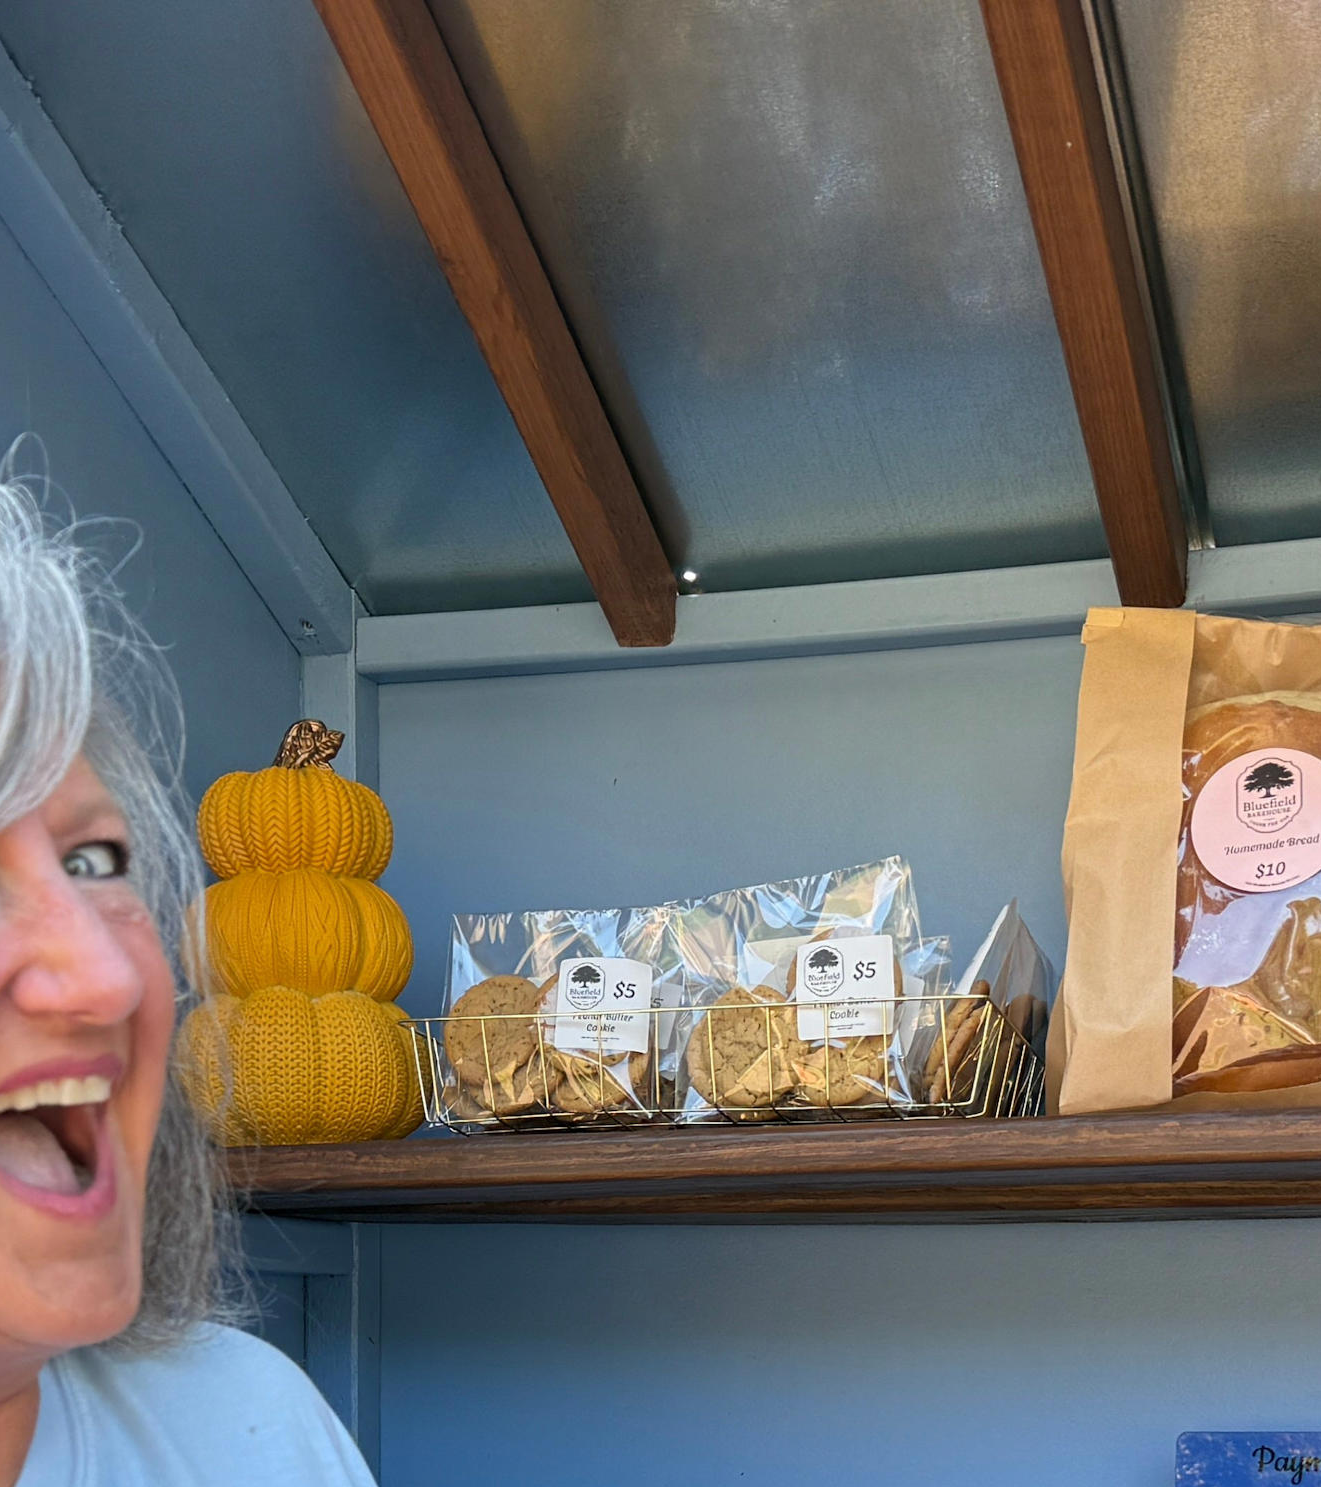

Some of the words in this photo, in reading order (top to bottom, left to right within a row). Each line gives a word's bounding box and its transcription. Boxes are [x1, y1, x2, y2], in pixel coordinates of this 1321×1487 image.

[1243, 794, 1296, 812] Bluefield
[1224, 839, 1285, 855] Homemade
[1286, 833, 1320, 848] Bread
[1255, 861, 1286, 879] $10
[853, 961, 876, 981] $5
[613, 981, 636, 1000] $5
